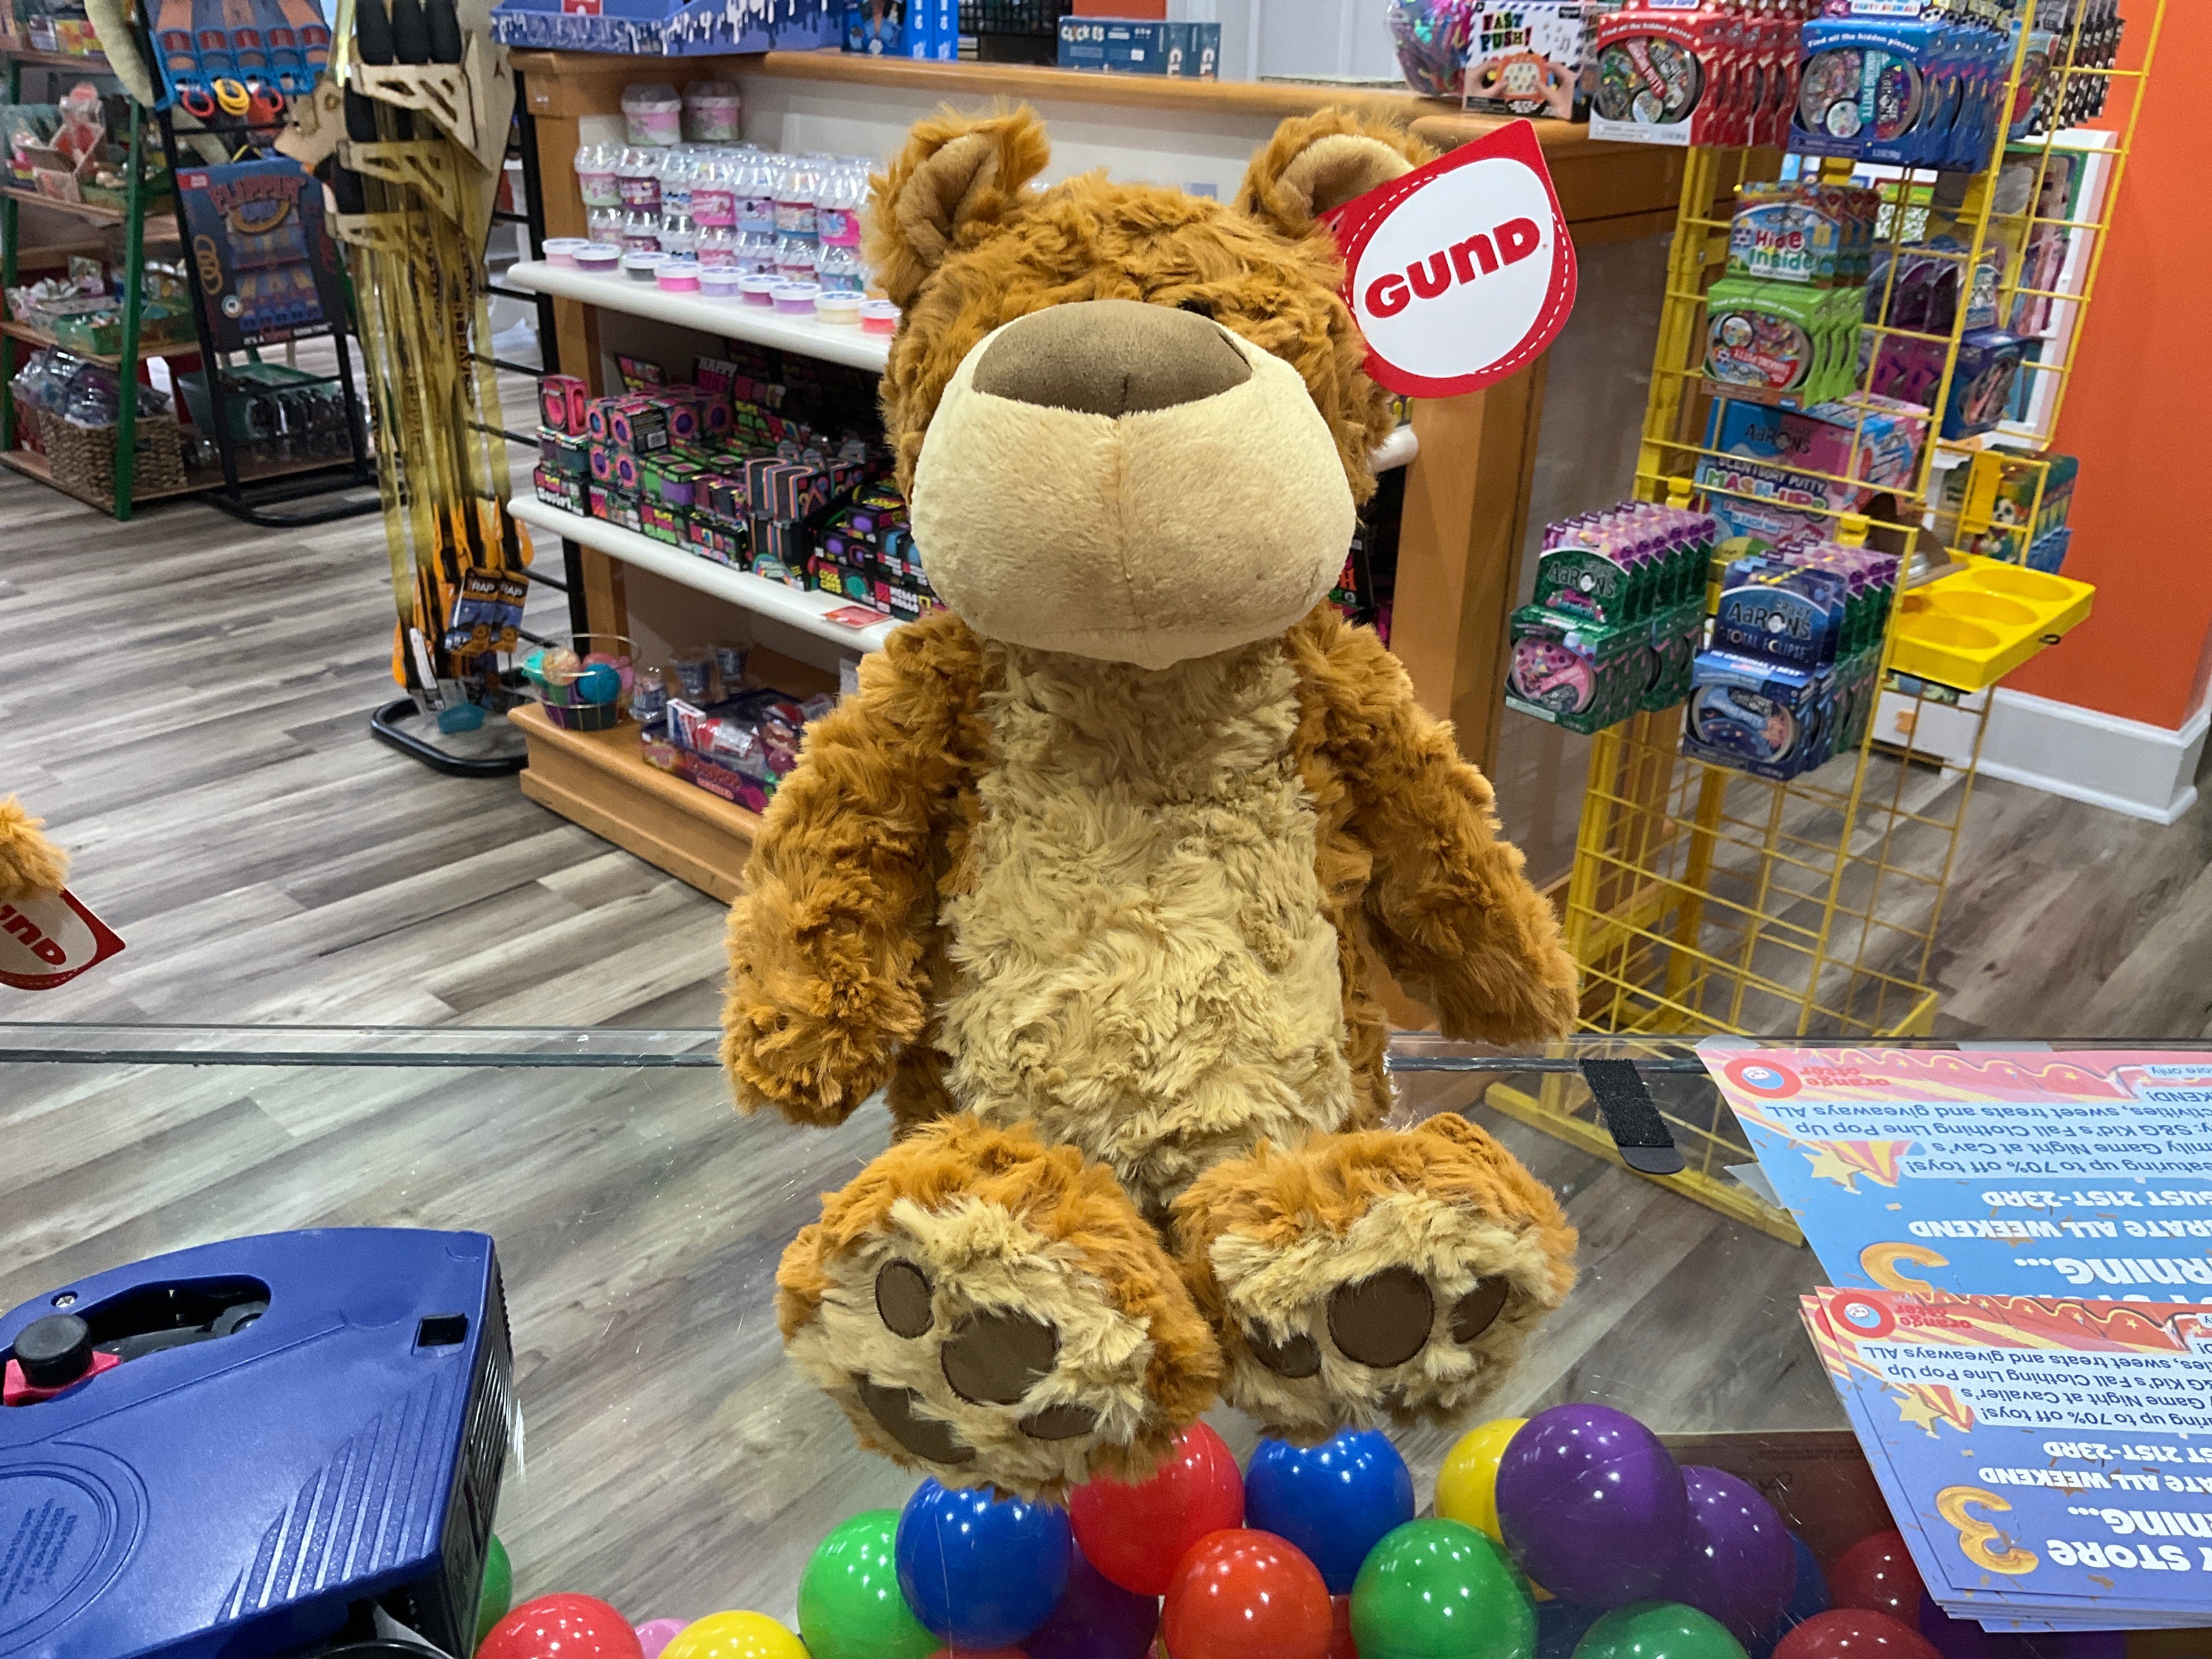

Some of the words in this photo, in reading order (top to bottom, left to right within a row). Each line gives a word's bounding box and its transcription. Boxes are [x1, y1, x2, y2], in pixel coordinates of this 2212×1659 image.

[1365, 217, 1540, 318] GUND
[1765, 1106, 1806, 1118] ALL
[1813, 1104, 1930, 1119] giveaways
[1934, 1107, 1976, 1118] and
[1981, 1108, 2049, 1119] treats
[2050, 1107, 2120, 1119] sweet
[1795, 1122, 1830, 1136] Up
[1832, 1122, 1881, 1136] Pop
[1883, 1125, 1932, 1136] Line
[1932, 1123, 2030, 1137] Clothing
[2032, 1126, 2078, 1137] Fall
[2078, 1125, 2137, 1137] Kid's
[2137, 1124, 2193, 1136] S&G
[1999, 1144, 2023, 1154] at
[2027, 1141, 2092, 1155] Night
[2094, 1143, 2162, 1155] Game
[1906, 1159, 1966, 1173] toys!
[1970, 1161, 2002, 1173] off
[2006, 1161, 2059, 1173] 70%
[2059, 1162, 2086, 1173] to
[2089, 1160, 2120, 1171] up
[1981, 1190, 2144, 1207] 21ST-23RD
[1908, 1220, 2063, 1238] WEEKEND
[2059, 1221, 2118, 1238] ALL
[1863, 1346, 1898, 1359] ALL
[1903, 1347, 2004, 1364] giveaways
[2008, 1353, 2045, 1365] and
[2047, 1355, 2108, 1369] treats
[2109, 1357, 2171, 1369] sweet
[1887, 1364, 1916, 1380] Up
[1918, 1365, 1960, 1381] Pop
[1962, 1370, 2004, 1383] Line
[2006, 1369, 2090, 1386] Clothing
[2092, 1375, 2132, 1389] Fall
[2134, 1377, 2185, 1391] Kid's
[1960, 1388, 2061, 1404] Cavalier's
[2062, 1392, 2084, 1404] at
[2086, 1392, 2144, 1407] Night
[2146, 1396, 2205, 1410] Game
[1980, 1406, 2032, 1422] toys!
[2035, 1410, 2063, 1423] off
[2067, 1412, 2112, 1425] 70%
[2114, 1414, 2136, 1426] to
[2140, 1413, 2166, 1425] up
[2042, 1441, 2185, 1463] 21ST-23RD
[1978, 1466, 2112, 1489] WEEKEND
[2109, 1474, 2159, 1491] ALL
